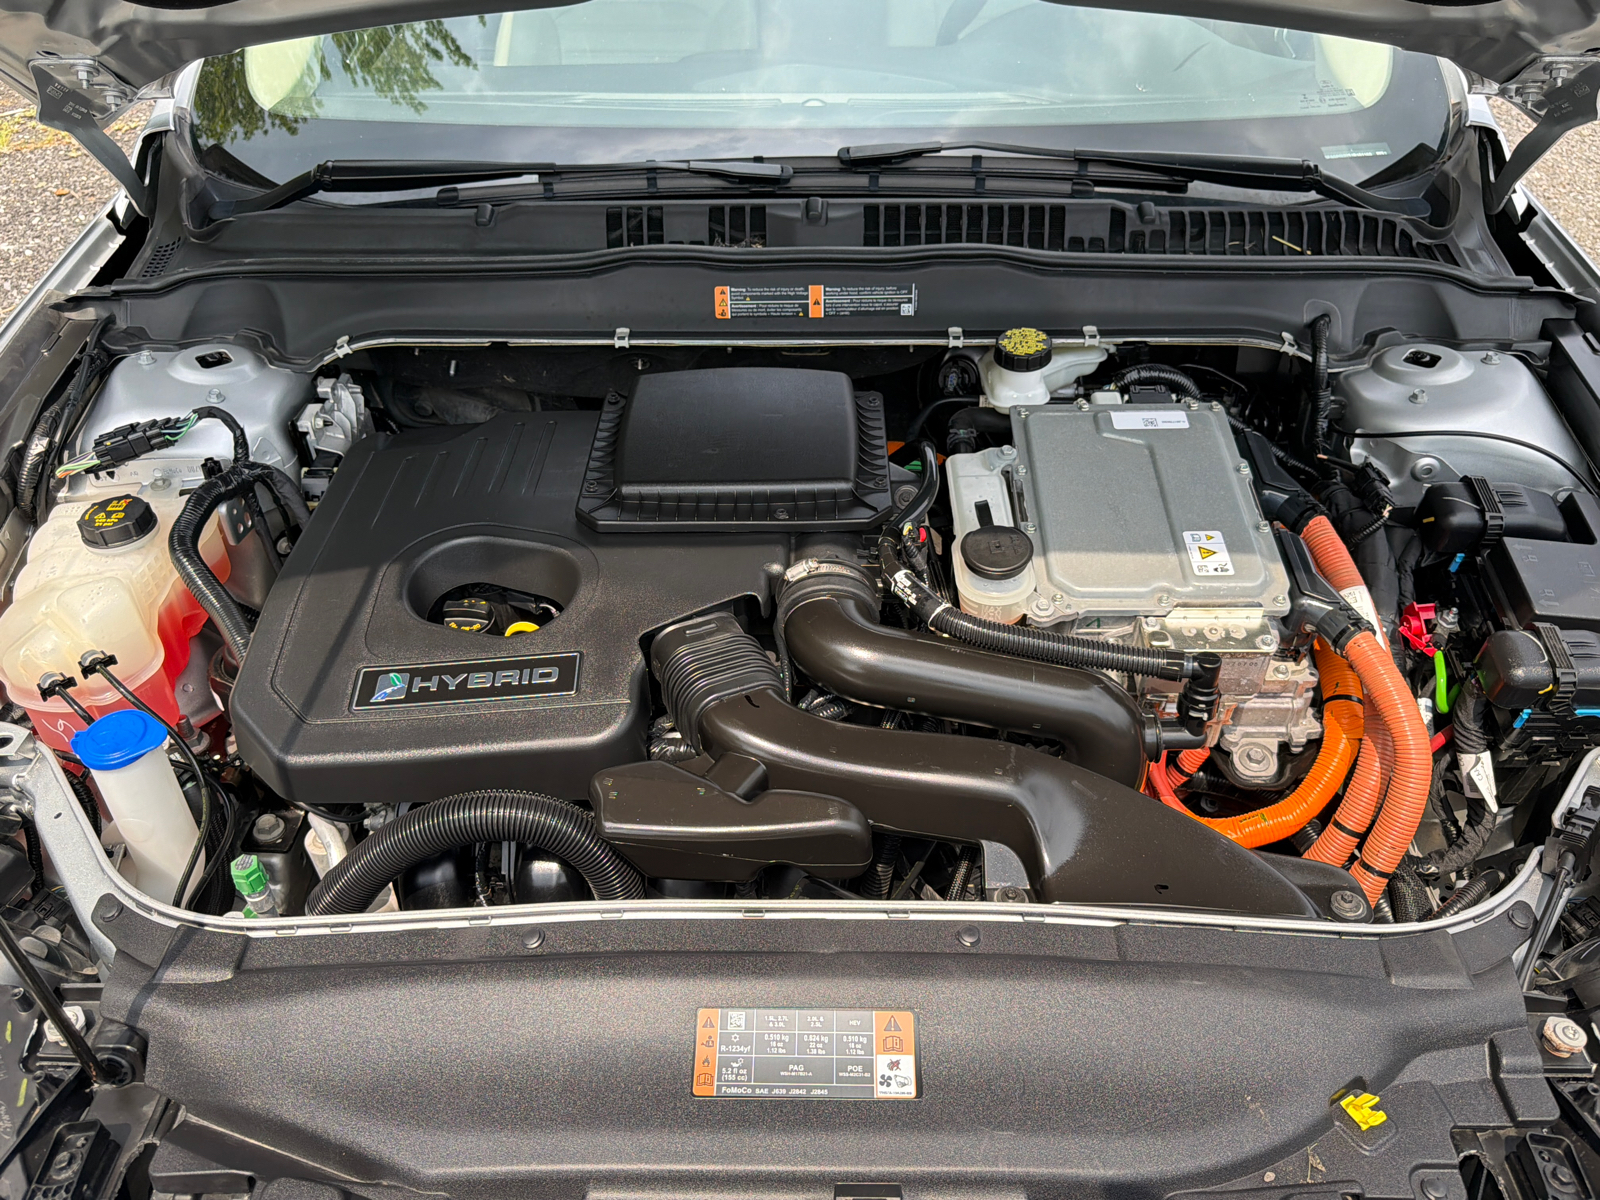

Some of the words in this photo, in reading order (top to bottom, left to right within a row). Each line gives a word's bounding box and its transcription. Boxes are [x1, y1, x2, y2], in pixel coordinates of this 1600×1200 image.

[411, 666, 560, 693] HYBRID
[782, 1034, 789, 1042] kg
[821, 1035, 828, 1043] kg
[860, 1036, 867, 1044] kg
[721, 1045, 751, 1053] R-1234yf
[722, 1086, 752, 1094] FoMoCo
